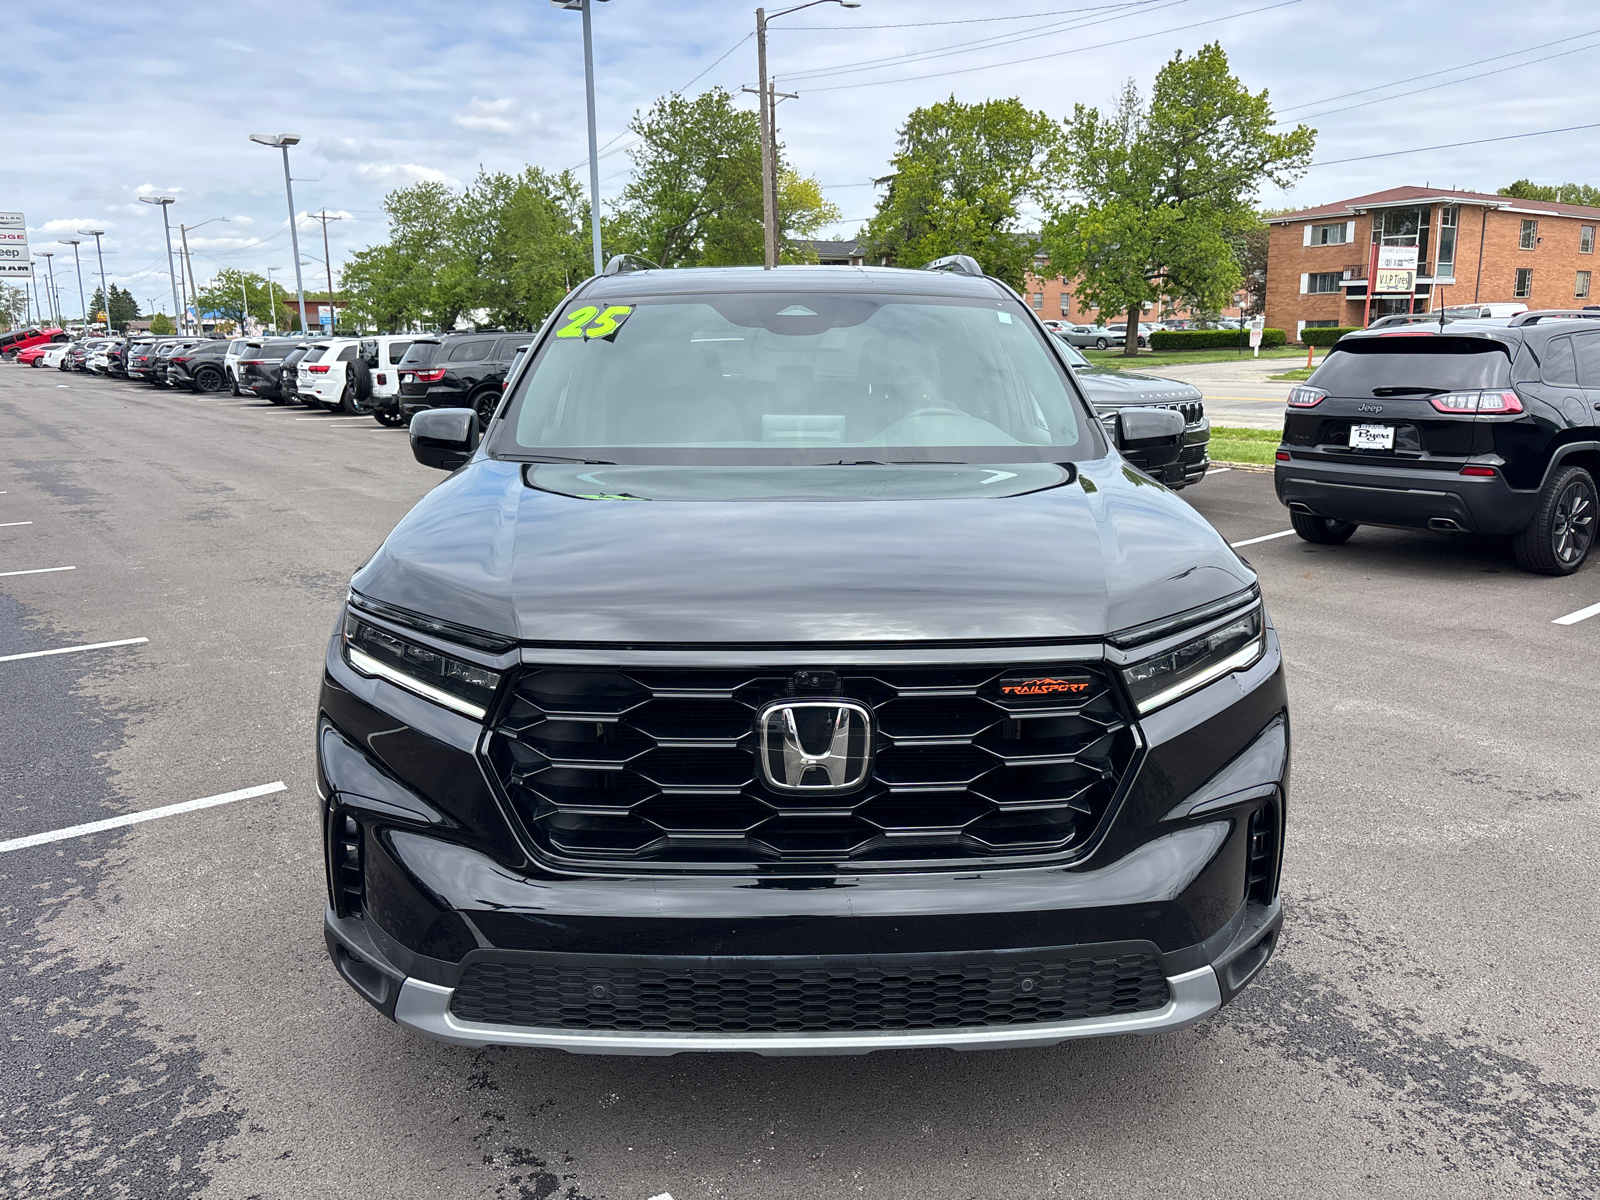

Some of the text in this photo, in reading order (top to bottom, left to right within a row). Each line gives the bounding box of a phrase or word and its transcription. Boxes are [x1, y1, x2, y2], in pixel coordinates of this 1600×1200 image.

[1394, 274, 1409, 285] Tires
[556, 306, 632, 338] 25
[1357, 403, 1383, 414] Jeep
[1354, 429, 1390, 441] Byers
[1001, 683, 1089, 695] TRAILSPORT
